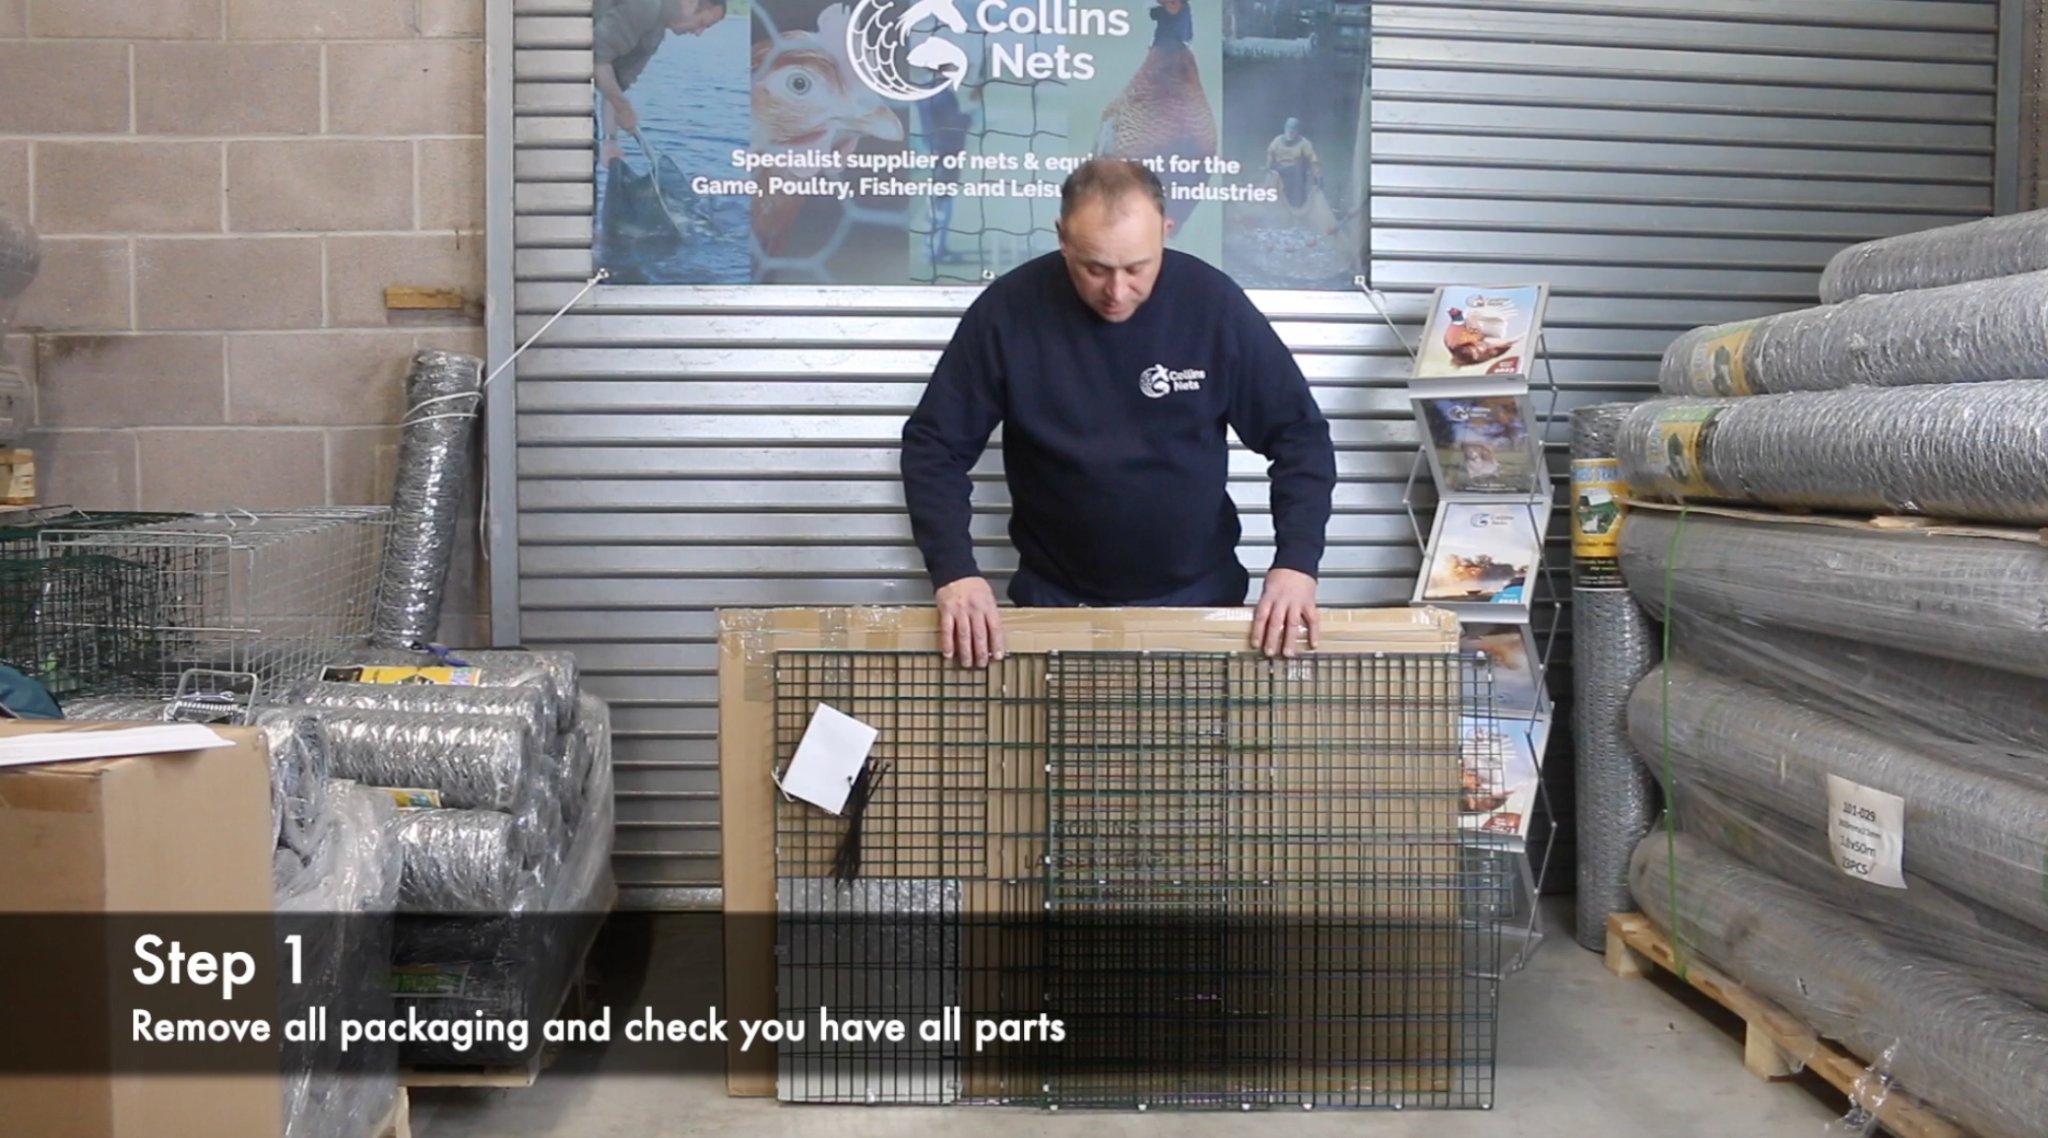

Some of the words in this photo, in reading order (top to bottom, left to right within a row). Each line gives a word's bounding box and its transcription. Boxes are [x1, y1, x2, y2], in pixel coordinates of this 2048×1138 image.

[976, 0, 1130, 36] Collins
[992, 43, 1095, 80] Nets
[731, 150, 841, 171] Specialist
[847, 151, 939, 172] supplier
[943, 151, 966, 168] of
[970, 153, 1018, 170] nets
[1023, 154, 1039, 169] &
[1169, 155, 1197, 173] for
[1203, 156, 1241, 174] the
[692, 176, 763, 197] Game,
[769, 177, 854, 200] Poultry,
[860, 177, 957, 196] Fisheries
[963, 179, 1005, 197] and
[1171, 182, 1278, 201] industries
[1169, 368, 1205, 381] Collins
[1173, 380, 1200, 392] Nets
